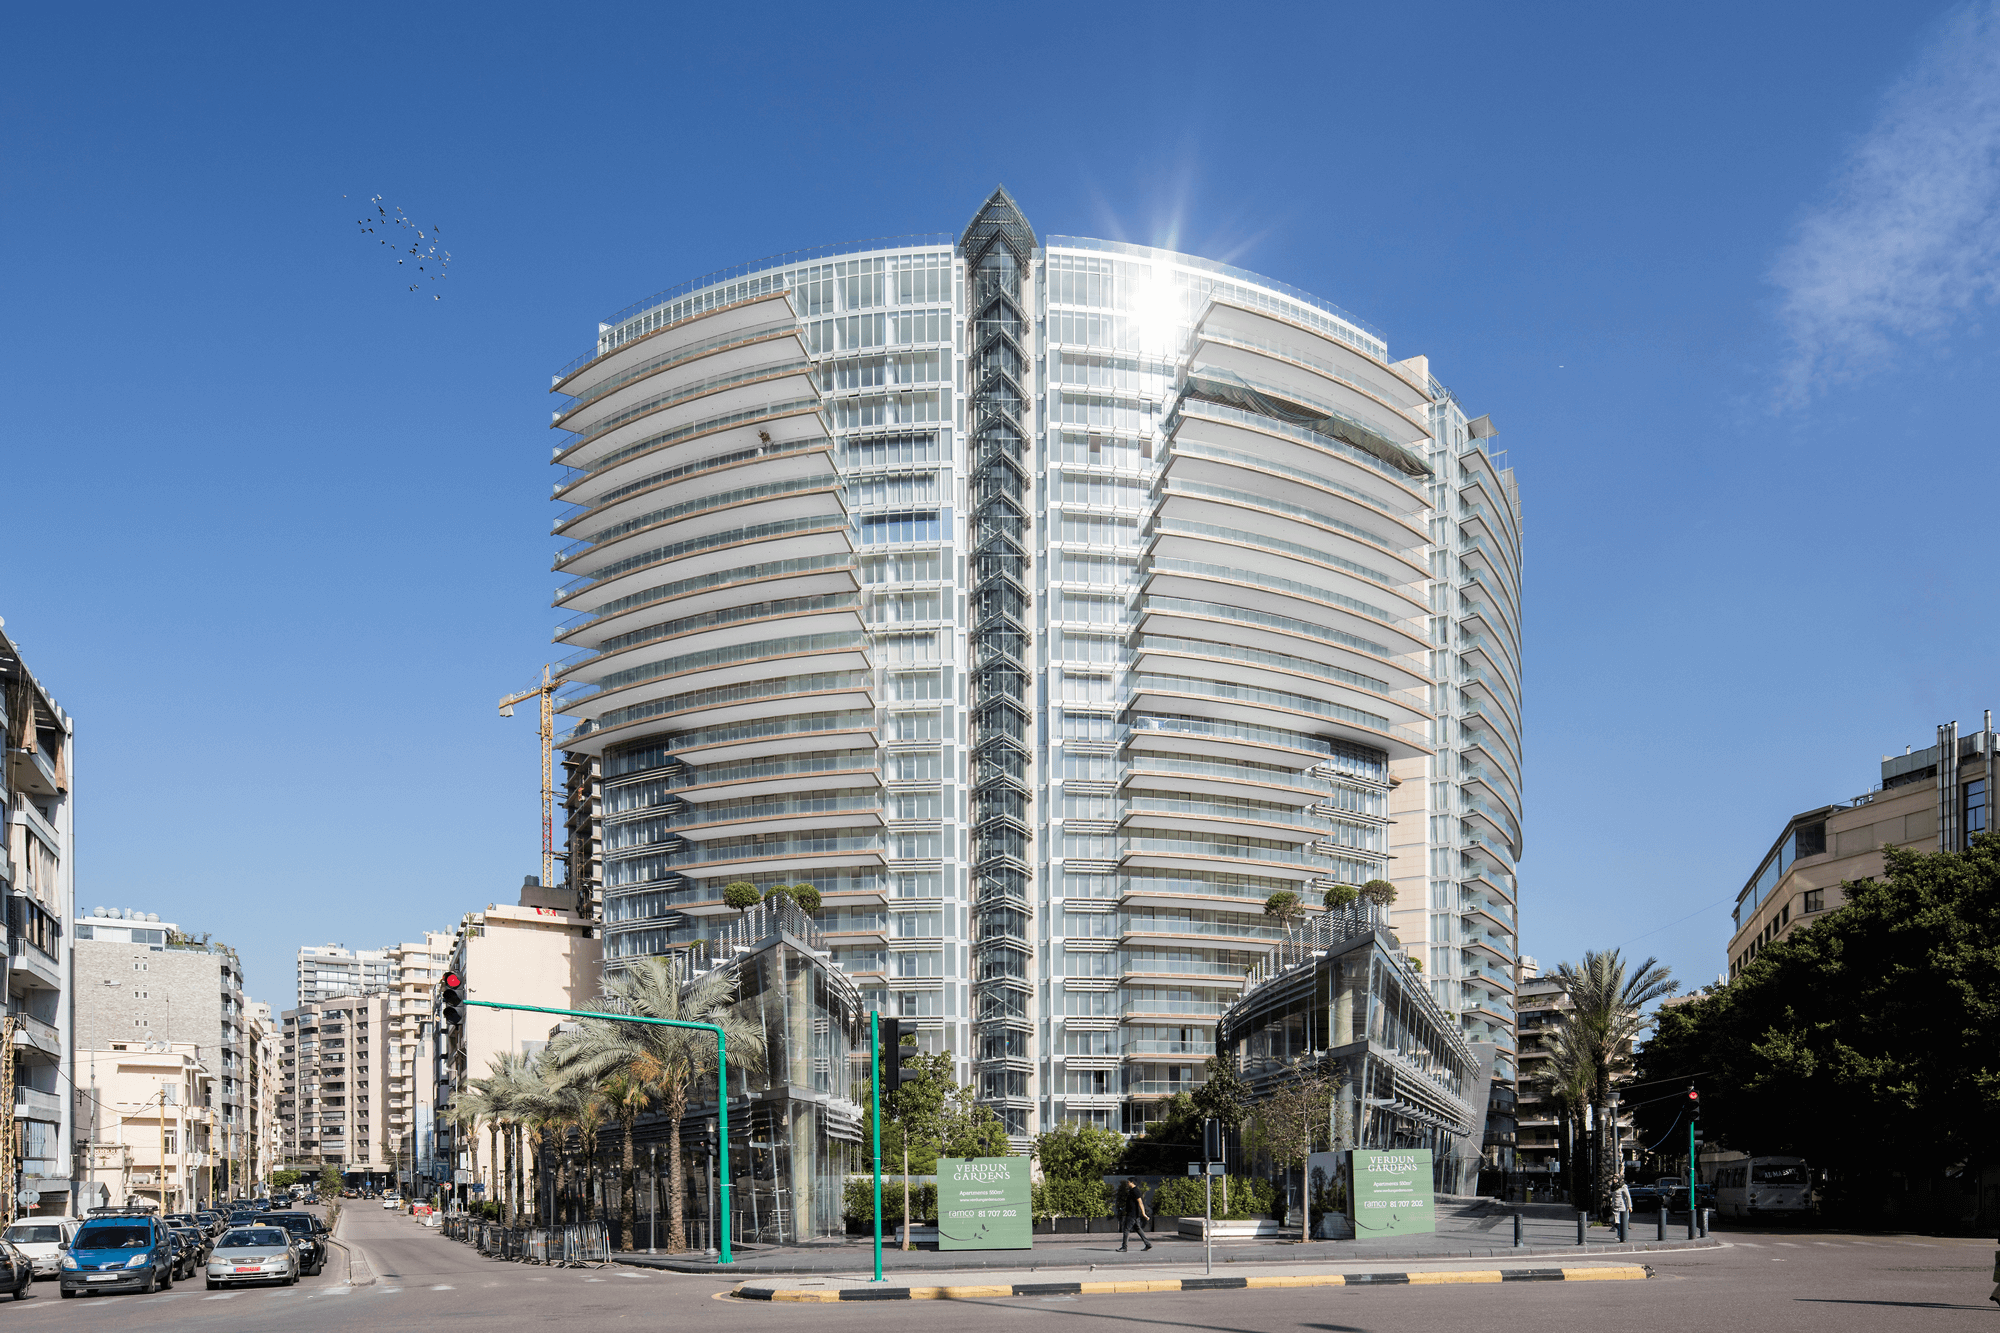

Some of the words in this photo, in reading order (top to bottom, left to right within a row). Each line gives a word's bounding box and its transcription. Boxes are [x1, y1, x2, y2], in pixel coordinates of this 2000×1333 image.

[956, 1164, 1007, 1172] VERDUN
[1368, 1164, 1417, 1174] GARDENS
[954, 1172, 1010, 1183] GARDENS
[1364, 1200, 1387, 1208] ramco
